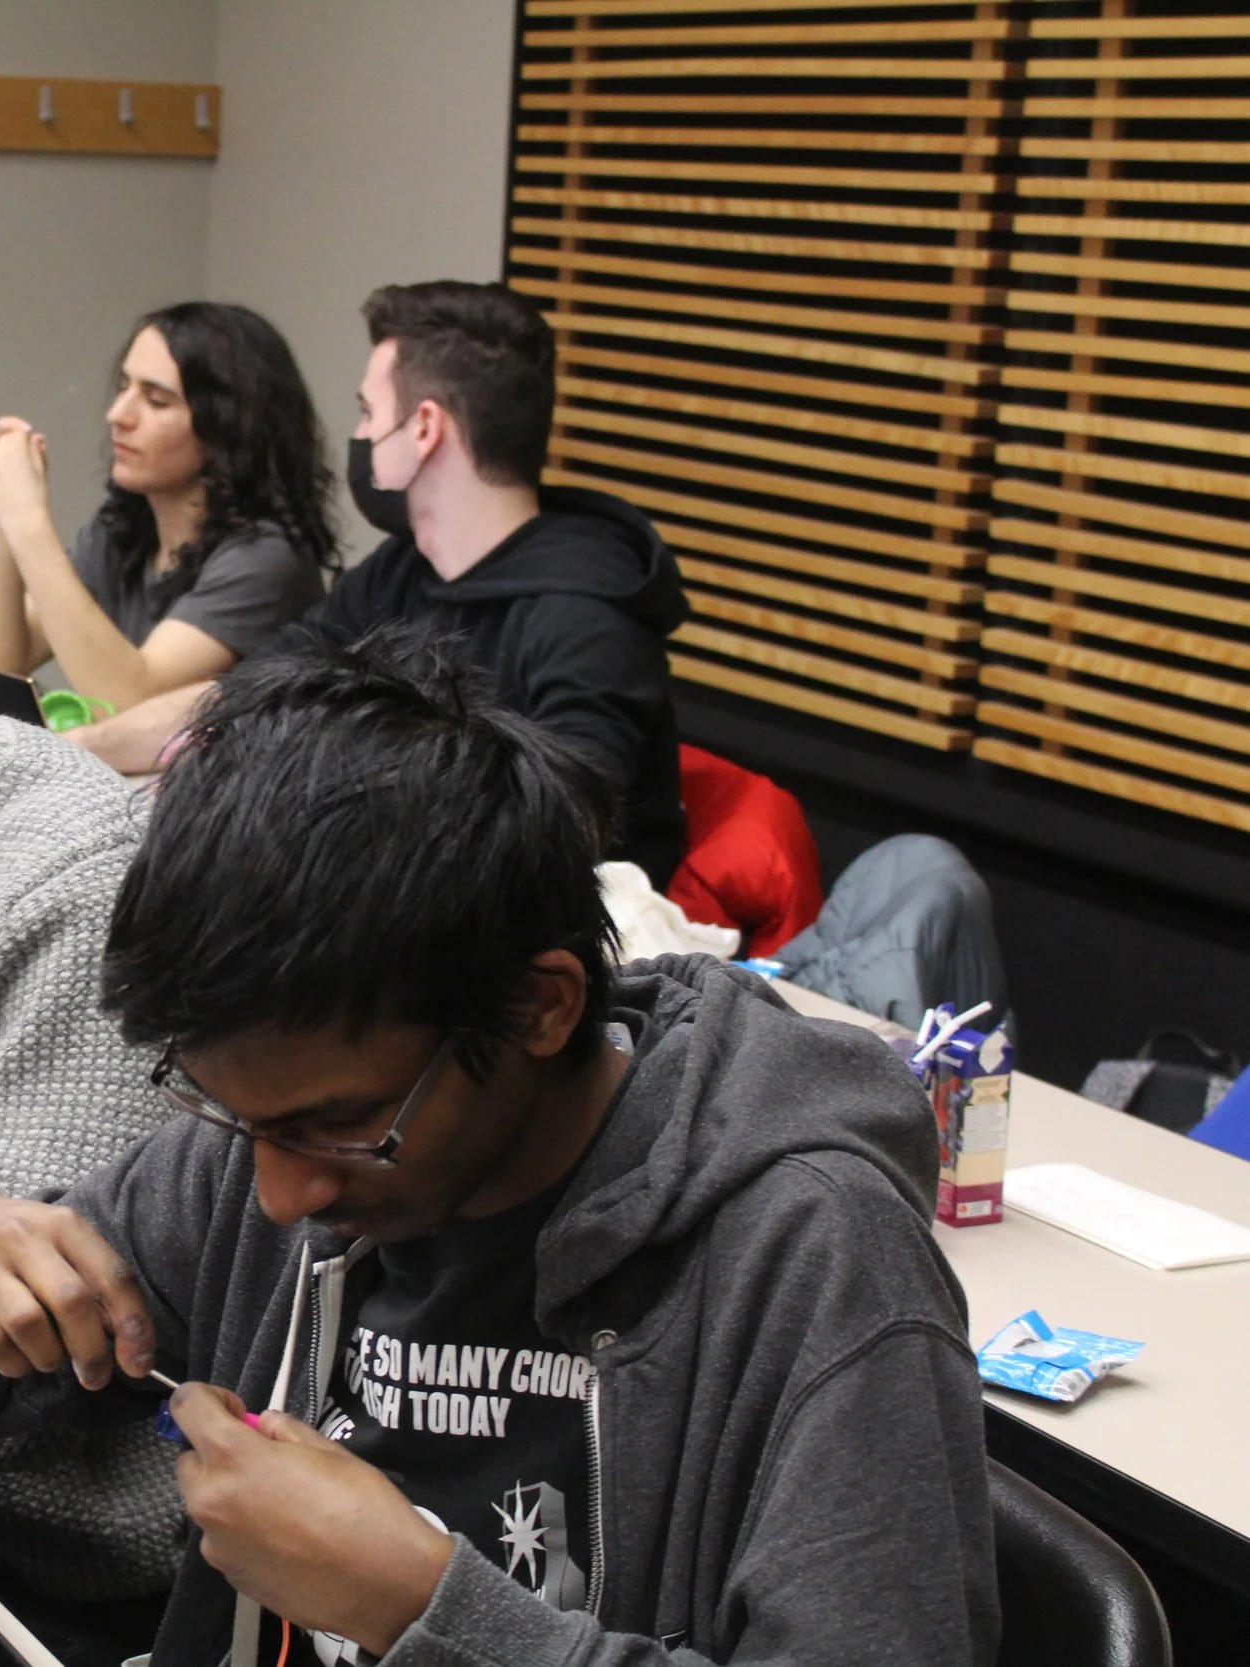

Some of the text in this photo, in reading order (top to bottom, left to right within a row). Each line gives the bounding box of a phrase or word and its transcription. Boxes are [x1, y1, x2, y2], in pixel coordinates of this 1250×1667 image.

[373, 1334, 402, 1381] SO
[408, 1342, 510, 1391] MANY
[408, 1390, 512, 1438] TODAY
